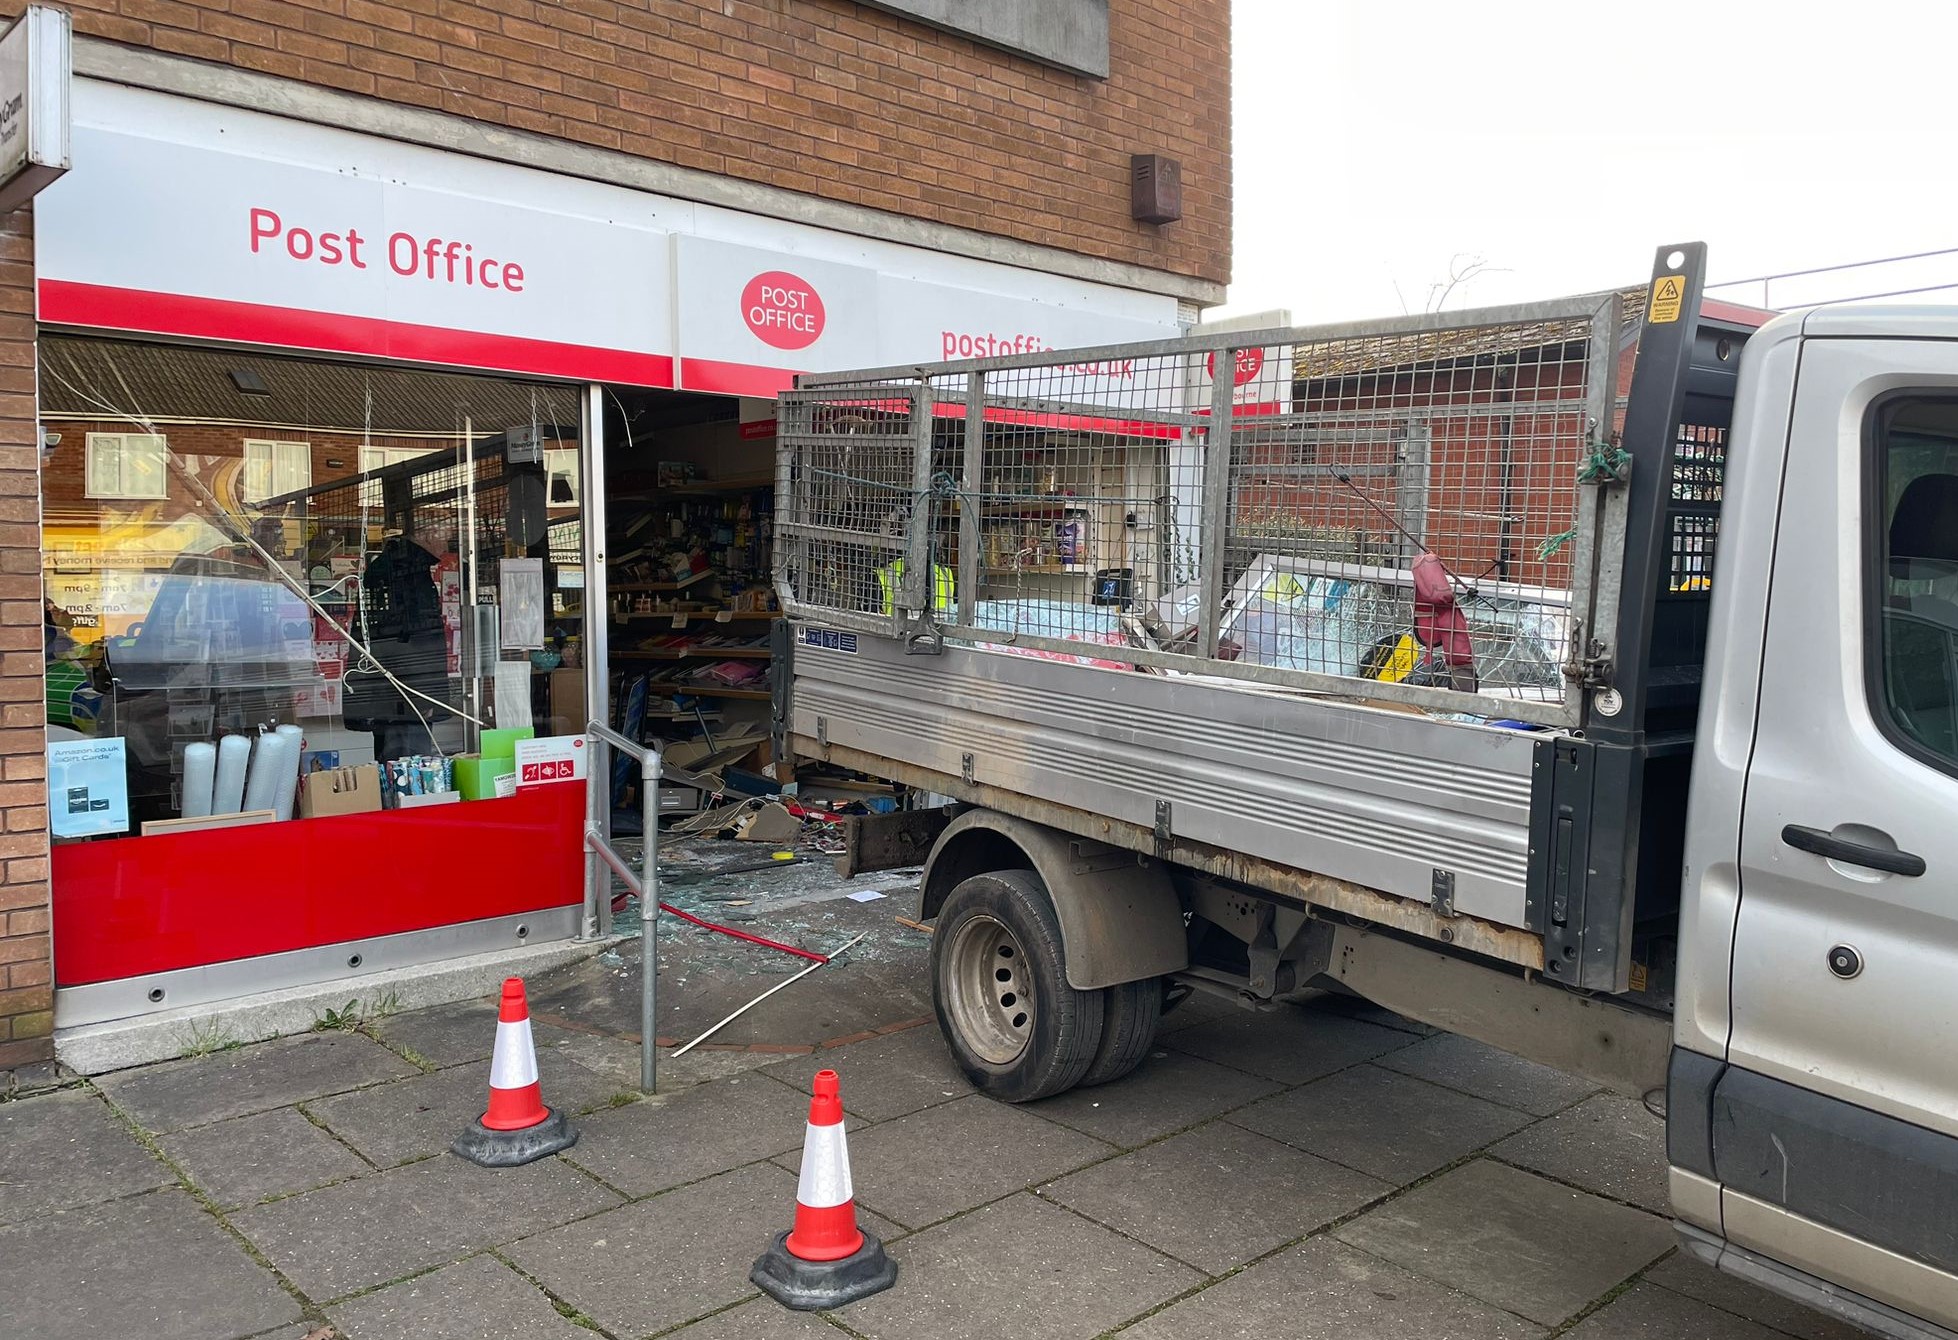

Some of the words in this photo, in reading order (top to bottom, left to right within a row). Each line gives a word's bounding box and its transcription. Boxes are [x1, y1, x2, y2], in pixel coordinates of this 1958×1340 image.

[250, 207, 367, 269] Post
[388, 232, 524, 292] Office
[762, 285, 808, 310] POST
[750, 306, 816, 333] OFFICE
[942, 331, 1133, 380] postoffi.co.uk
[55, 745, 120, 757] Amazon.co.uk
[62, 755, 80, 763] Gift
